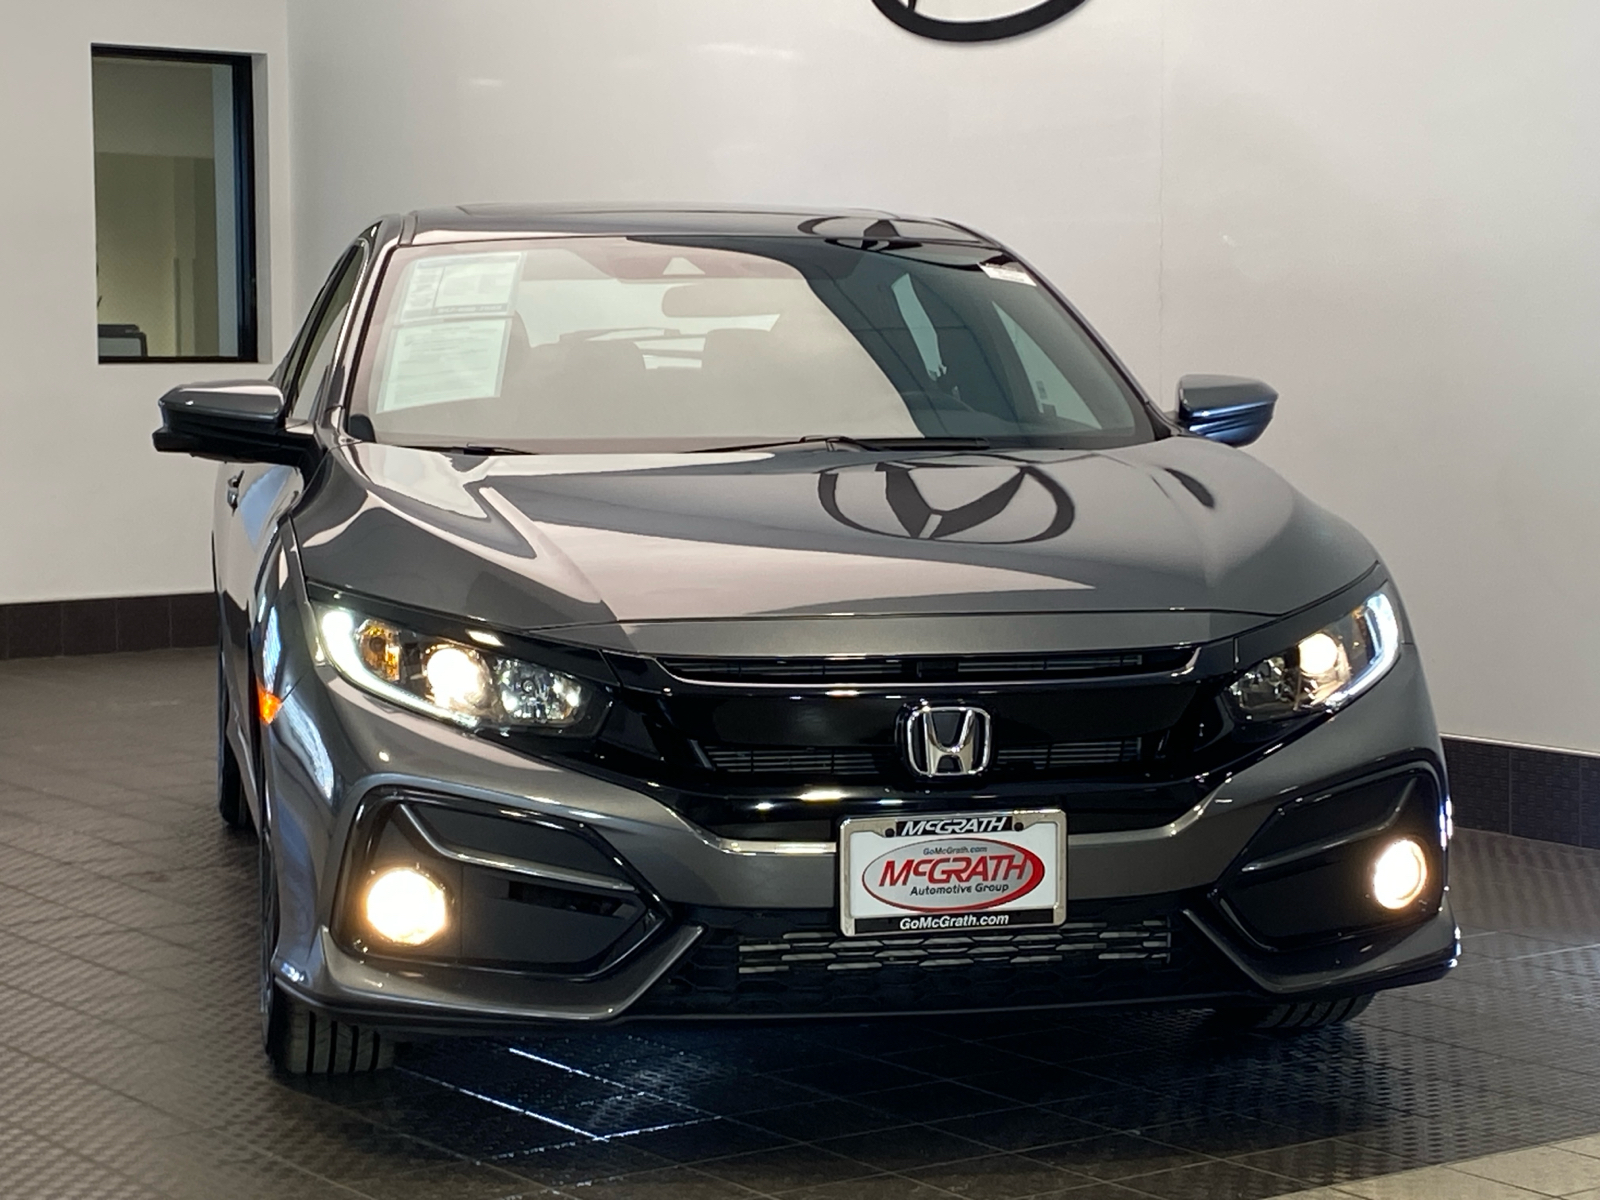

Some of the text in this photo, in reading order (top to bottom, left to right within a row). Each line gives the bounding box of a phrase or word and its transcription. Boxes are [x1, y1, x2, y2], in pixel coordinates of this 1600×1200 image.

[923, 846, 987, 856] GoMcGrath.com
[910, 883, 1009, 896] Automotive Group
[900, 914, 1009, 930] GoMcGrath.com
